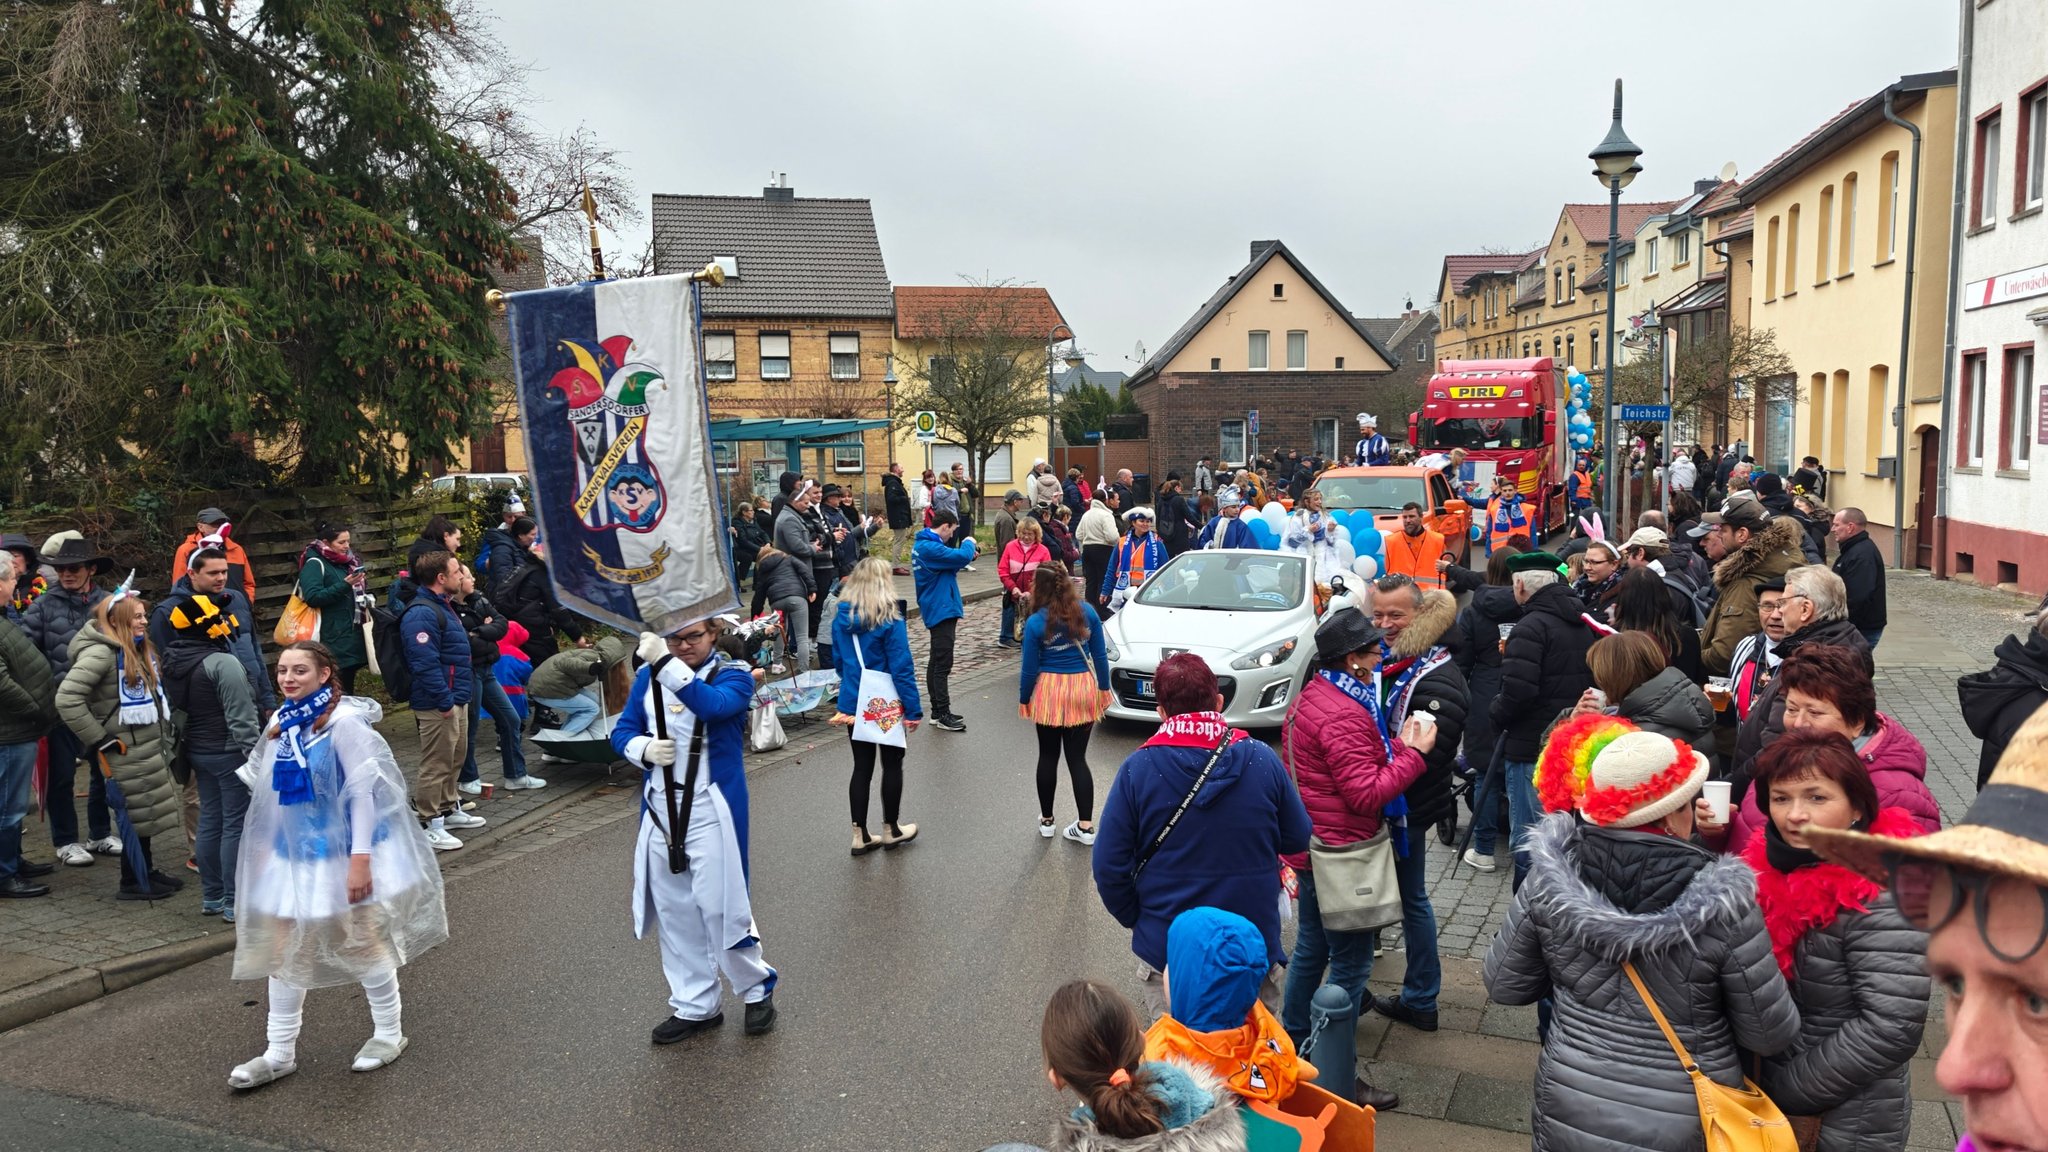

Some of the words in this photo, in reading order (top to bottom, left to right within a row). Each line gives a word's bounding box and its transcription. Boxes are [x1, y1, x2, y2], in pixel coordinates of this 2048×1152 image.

[2004, 271, 2048, 296] Unterwäsch
[1458, 387, 1498, 397] PIRL
[569, 396, 647, 419] SANDERSDORFER
[1625, 407, 1669, 418] Teichstr.
[577, 421, 640, 513] KARNEVALSVEREIN
[1203, 754, 1219, 776] WOMAN
[1193, 774, 1205, 792] MUJER
[1169, 808, 1184, 826] DONNA
